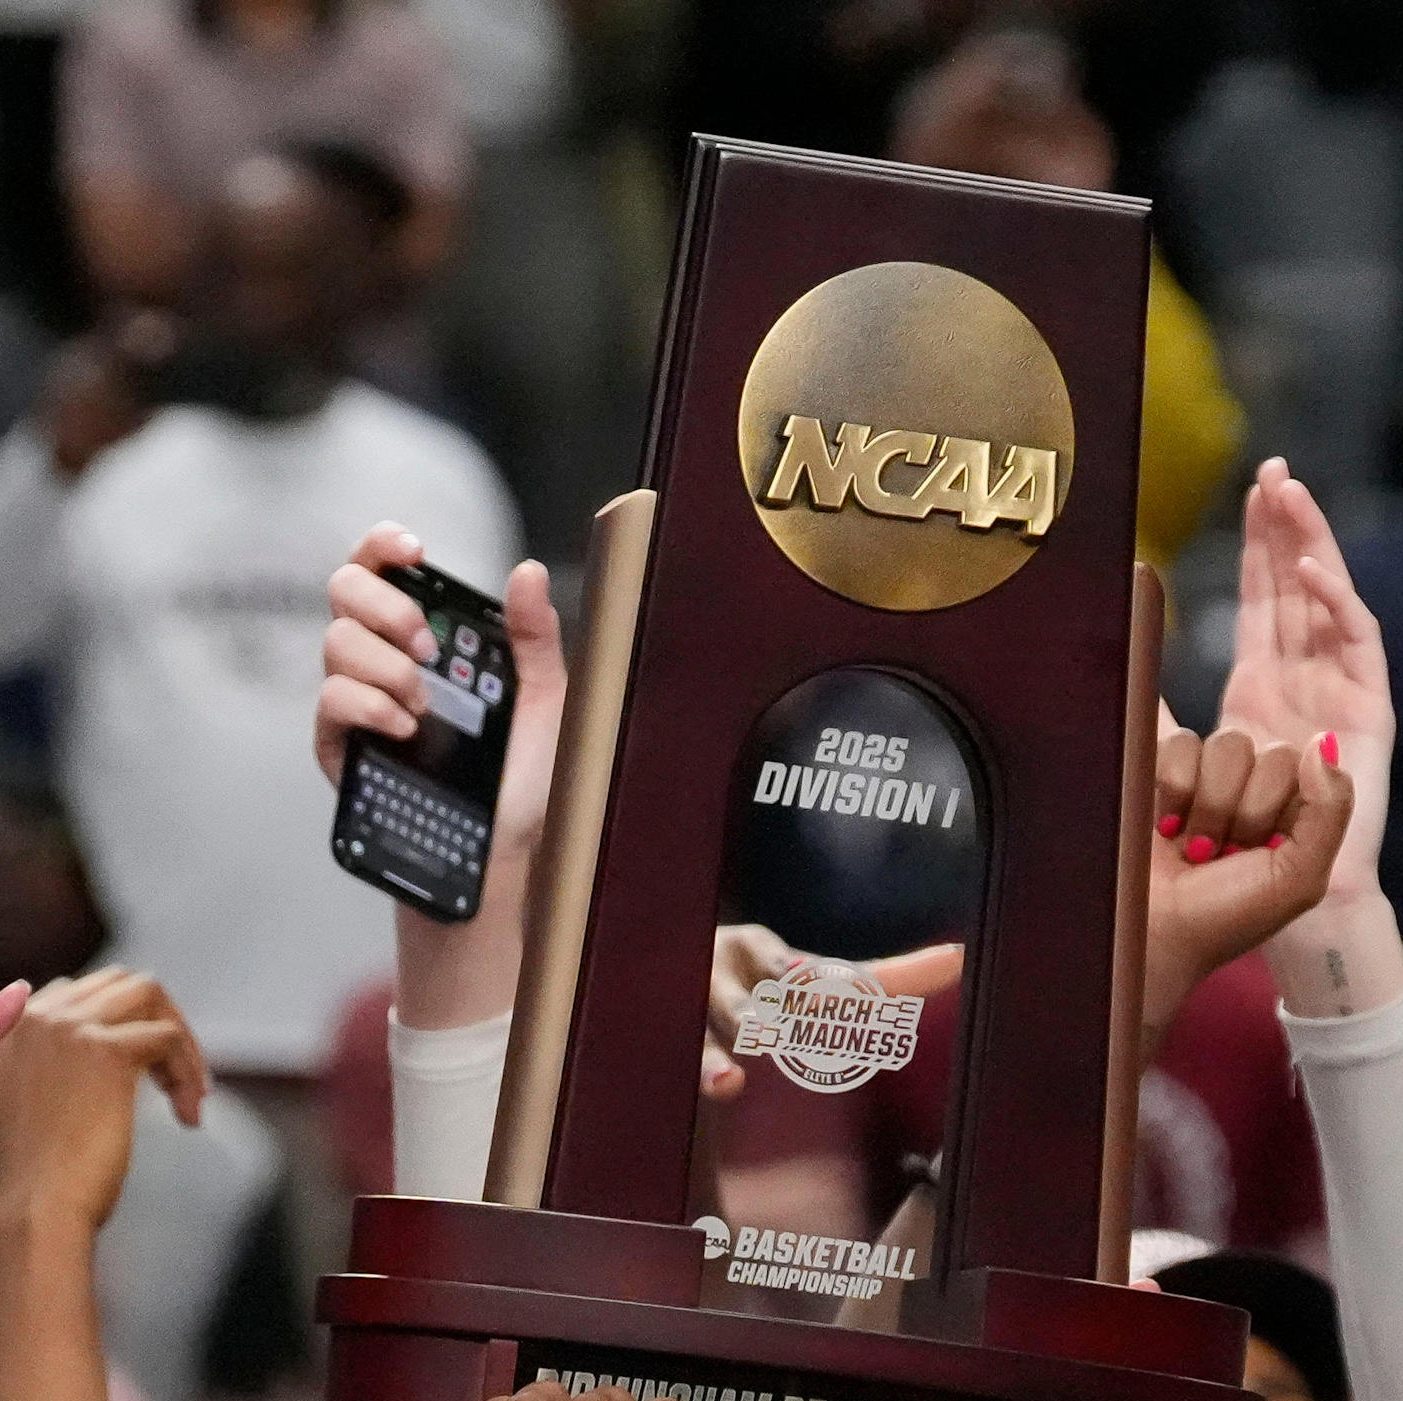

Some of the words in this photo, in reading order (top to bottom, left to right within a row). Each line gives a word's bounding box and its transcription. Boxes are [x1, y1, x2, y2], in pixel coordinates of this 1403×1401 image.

[765, 414, 1058, 538] NCAA
[814, 727, 910, 773] 2025
[753, 760, 937, 826] DIVISION
[941, 787, 961, 828] I
[780, 988, 875, 1025] MARCH
[788, 1019, 913, 1059] MADNESS
[733, 1226, 916, 1281] BASKETBALL
[727, 1260, 884, 1300] CHAMPIONSHIP
